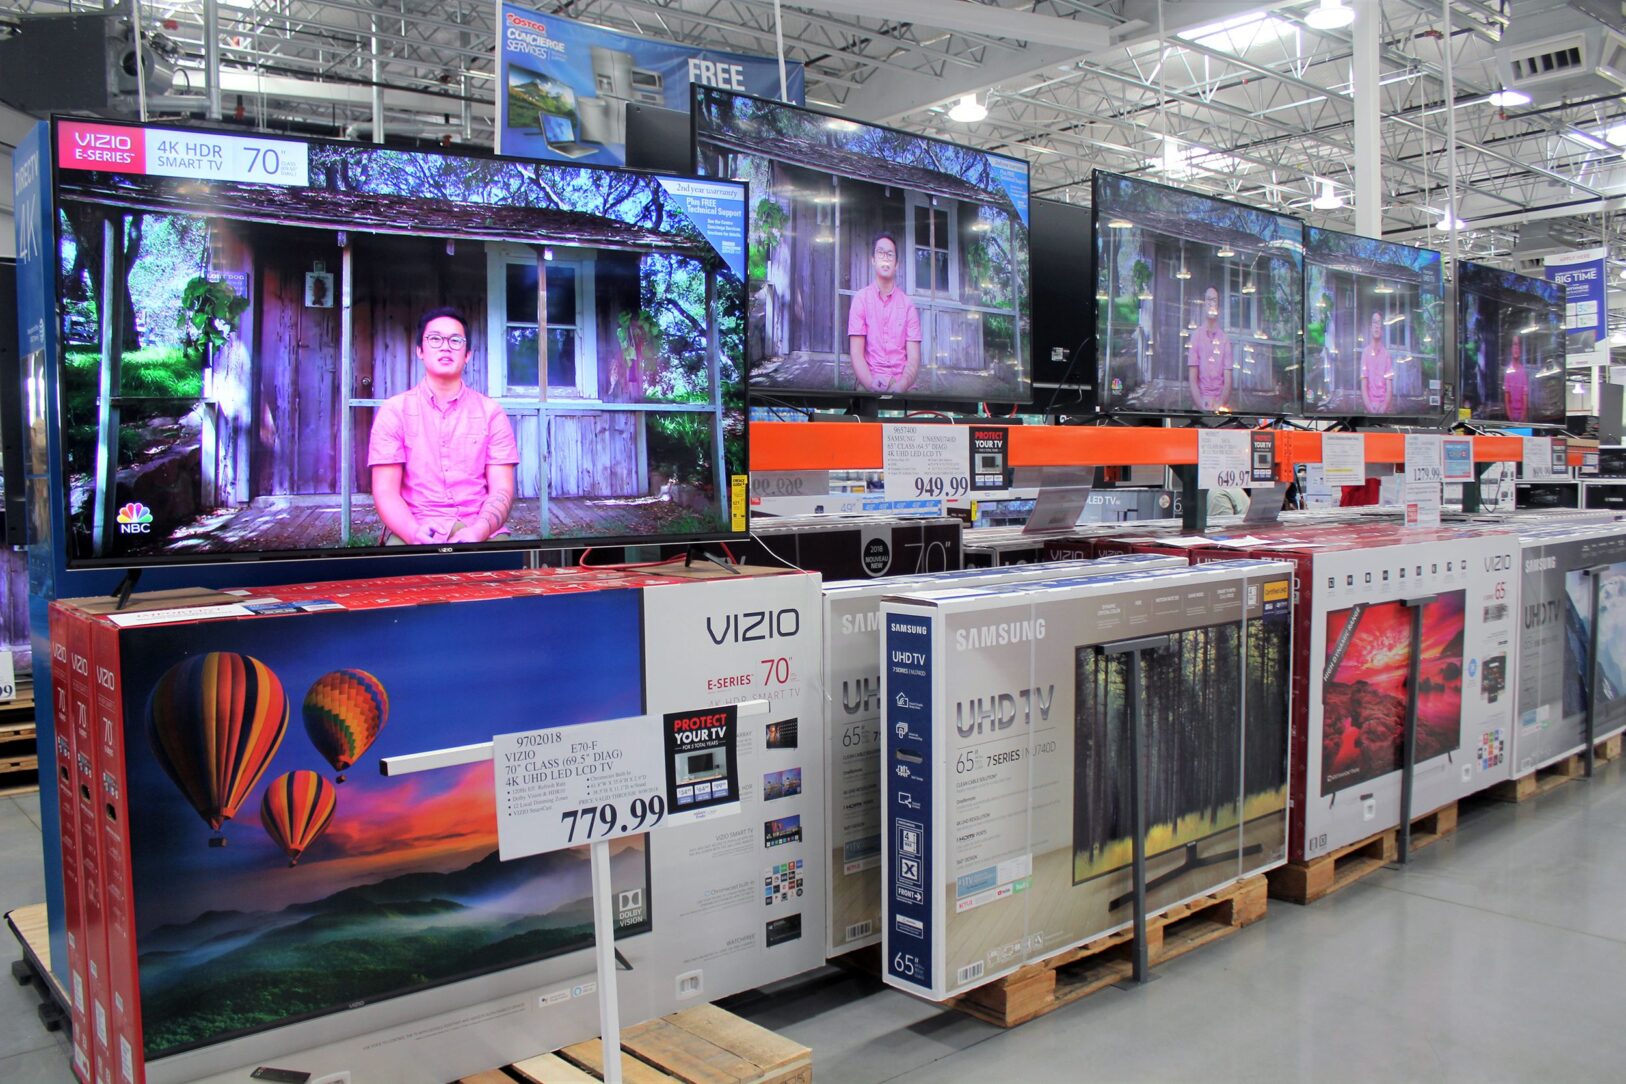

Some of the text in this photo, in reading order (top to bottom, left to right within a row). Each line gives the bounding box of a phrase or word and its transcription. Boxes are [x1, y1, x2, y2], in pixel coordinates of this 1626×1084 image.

[506, 13, 545, 32] COSTCO
[507, 28, 565, 52] CONCIERGE
[507, 40, 548, 59] SERVICES
[688, 58, 746, 92] FREE
[75, 132, 131, 150] VIZIO
[157, 140, 179, 155] 4K
[185, 142, 223, 159] HDR
[158, 156, 223, 171] SMART TV
[15, 151, 39, 196] DIRECTV
[677, 184, 738, 197] 2nd year warranty
[687, 206, 741, 217] Technical Support
[701, 199, 716, 207] FREE
[19, 193, 38, 264] 4K
[1555, 274, 1572, 285] BIG
[1573, 271, 1597, 281] TIME
[975, 431, 1003, 439] PROTECT
[975, 440, 1003, 448] YOUR TV
[914, 476, 969, 497] 949.99
[1217, 470, 1250, 487] 649.97
[1105, 496, 1116, 505] TV
[120, 523, 151, 534] NBC
[1050, 550, 1084, 561] VIZIO
[1484, 554, 1511, 573] VIZIO
[1525, 556, 1556, 573] SAMSUNG
[706, 608, 800, 645] VIZIO
[891, 623, 927, 635] SAMSUNG
[955, 618, 1046, 652] SAMSUNG
[53, 642, 67, 663] VIZIO
[1323, 606, 1360, 682] HIGH DYNAMIC RANGE
[71, 652, 88, 676] VIZIO
[892, 650, 926, 666] UHD TV
[96, 665, 115, 691] VIZIO
[752, 690, 785, 700] SMART
[790, 688, 801, 697] TV
[956, 684, 1055, 739] UHD TV
[674, 713, 727, 732] PROTECT
[516, 732, 562, 748] 9702018
[674, 726, 727, 745] YOUR TV
[505, 740, 598, 763] VIZIO E70-F
[524, 759, 560, 773] CLASS
[593, 749, 623, 762] DIAG)
[506, 761, 614, 788] 4K UHD LED LCD TV
[561, 794, 665, 843] 779.99
[898, 887, 914, 898] FRONT
[619, 908, 642, 920] DOLBY
[620, 916, 643, 928] VISION
